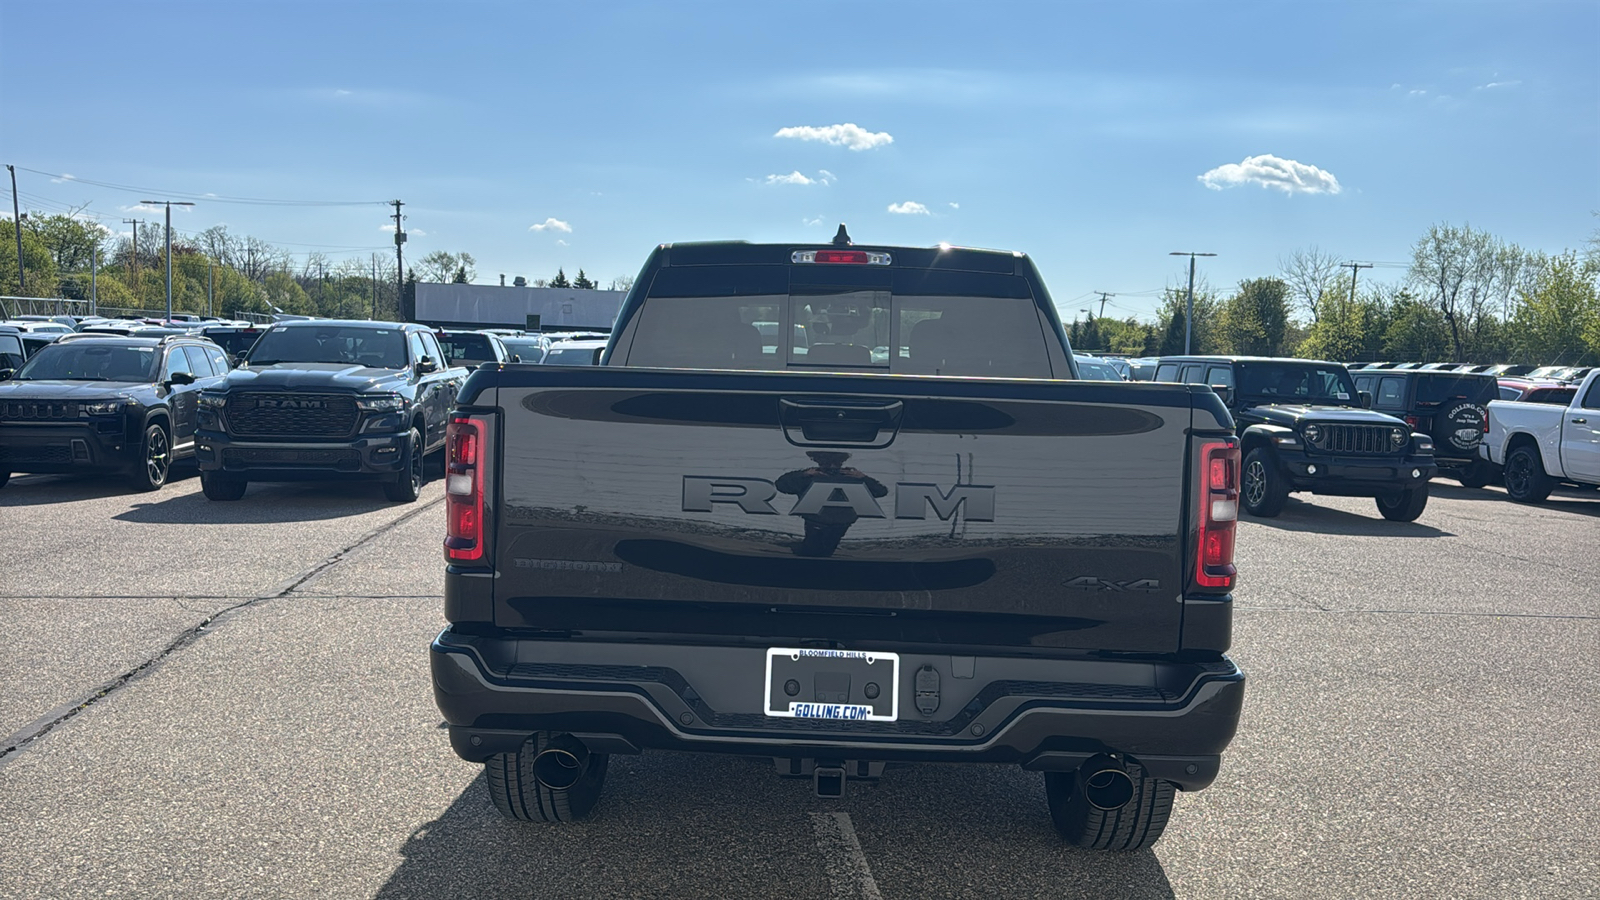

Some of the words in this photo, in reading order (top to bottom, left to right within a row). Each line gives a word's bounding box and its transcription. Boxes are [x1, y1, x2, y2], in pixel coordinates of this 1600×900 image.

[258, 399, 321, 409] RAM
[681, 474, 996, 522] RAM
[799, 649, 845, 659] BLOOMFIELD
[846, 651, 867, 660] HILLS
[794, 703, 868, 721] GOLLING.COM
